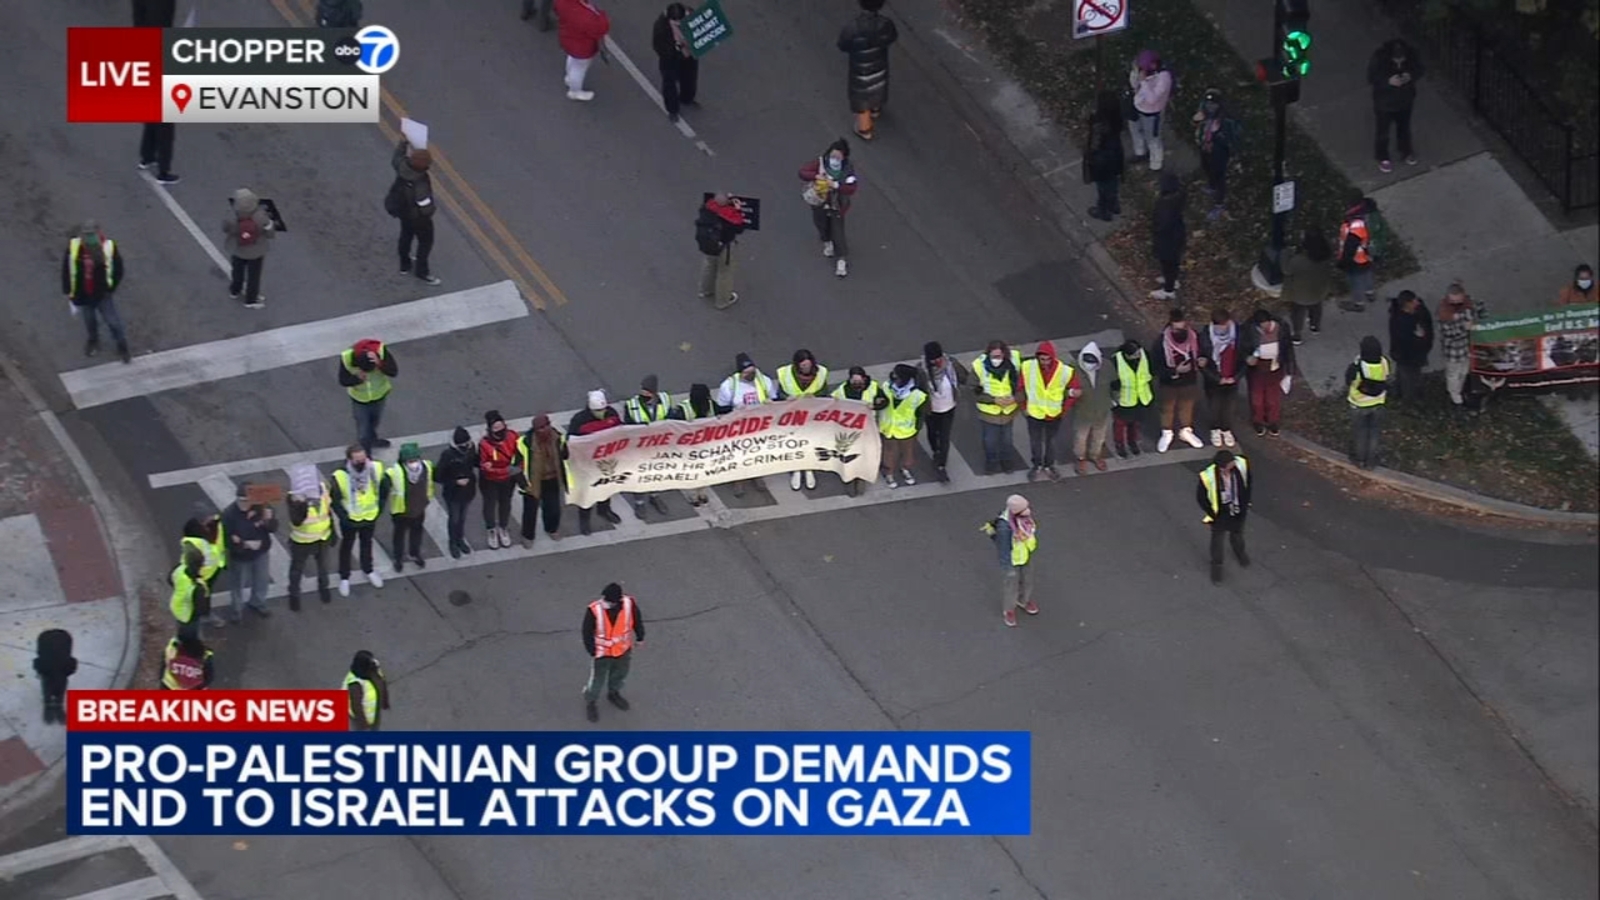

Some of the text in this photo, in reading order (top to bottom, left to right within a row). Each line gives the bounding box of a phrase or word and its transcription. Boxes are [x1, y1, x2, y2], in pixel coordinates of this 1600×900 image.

[592, 409, 868, 459] END THE GENOCIDE ON GAZA
[652, 431, 794, 460] JAN SCHAKOWS
[638, 462, 677, 473] SIGN
[682, 463, 705, 471] HR
[742, 446, 761, 456] TO
[767, 439, 810, 450] STOP
[638, 450, 806, 484] ISRAELI WAR CRIMES
[172, 662, 203, 679] STOP
